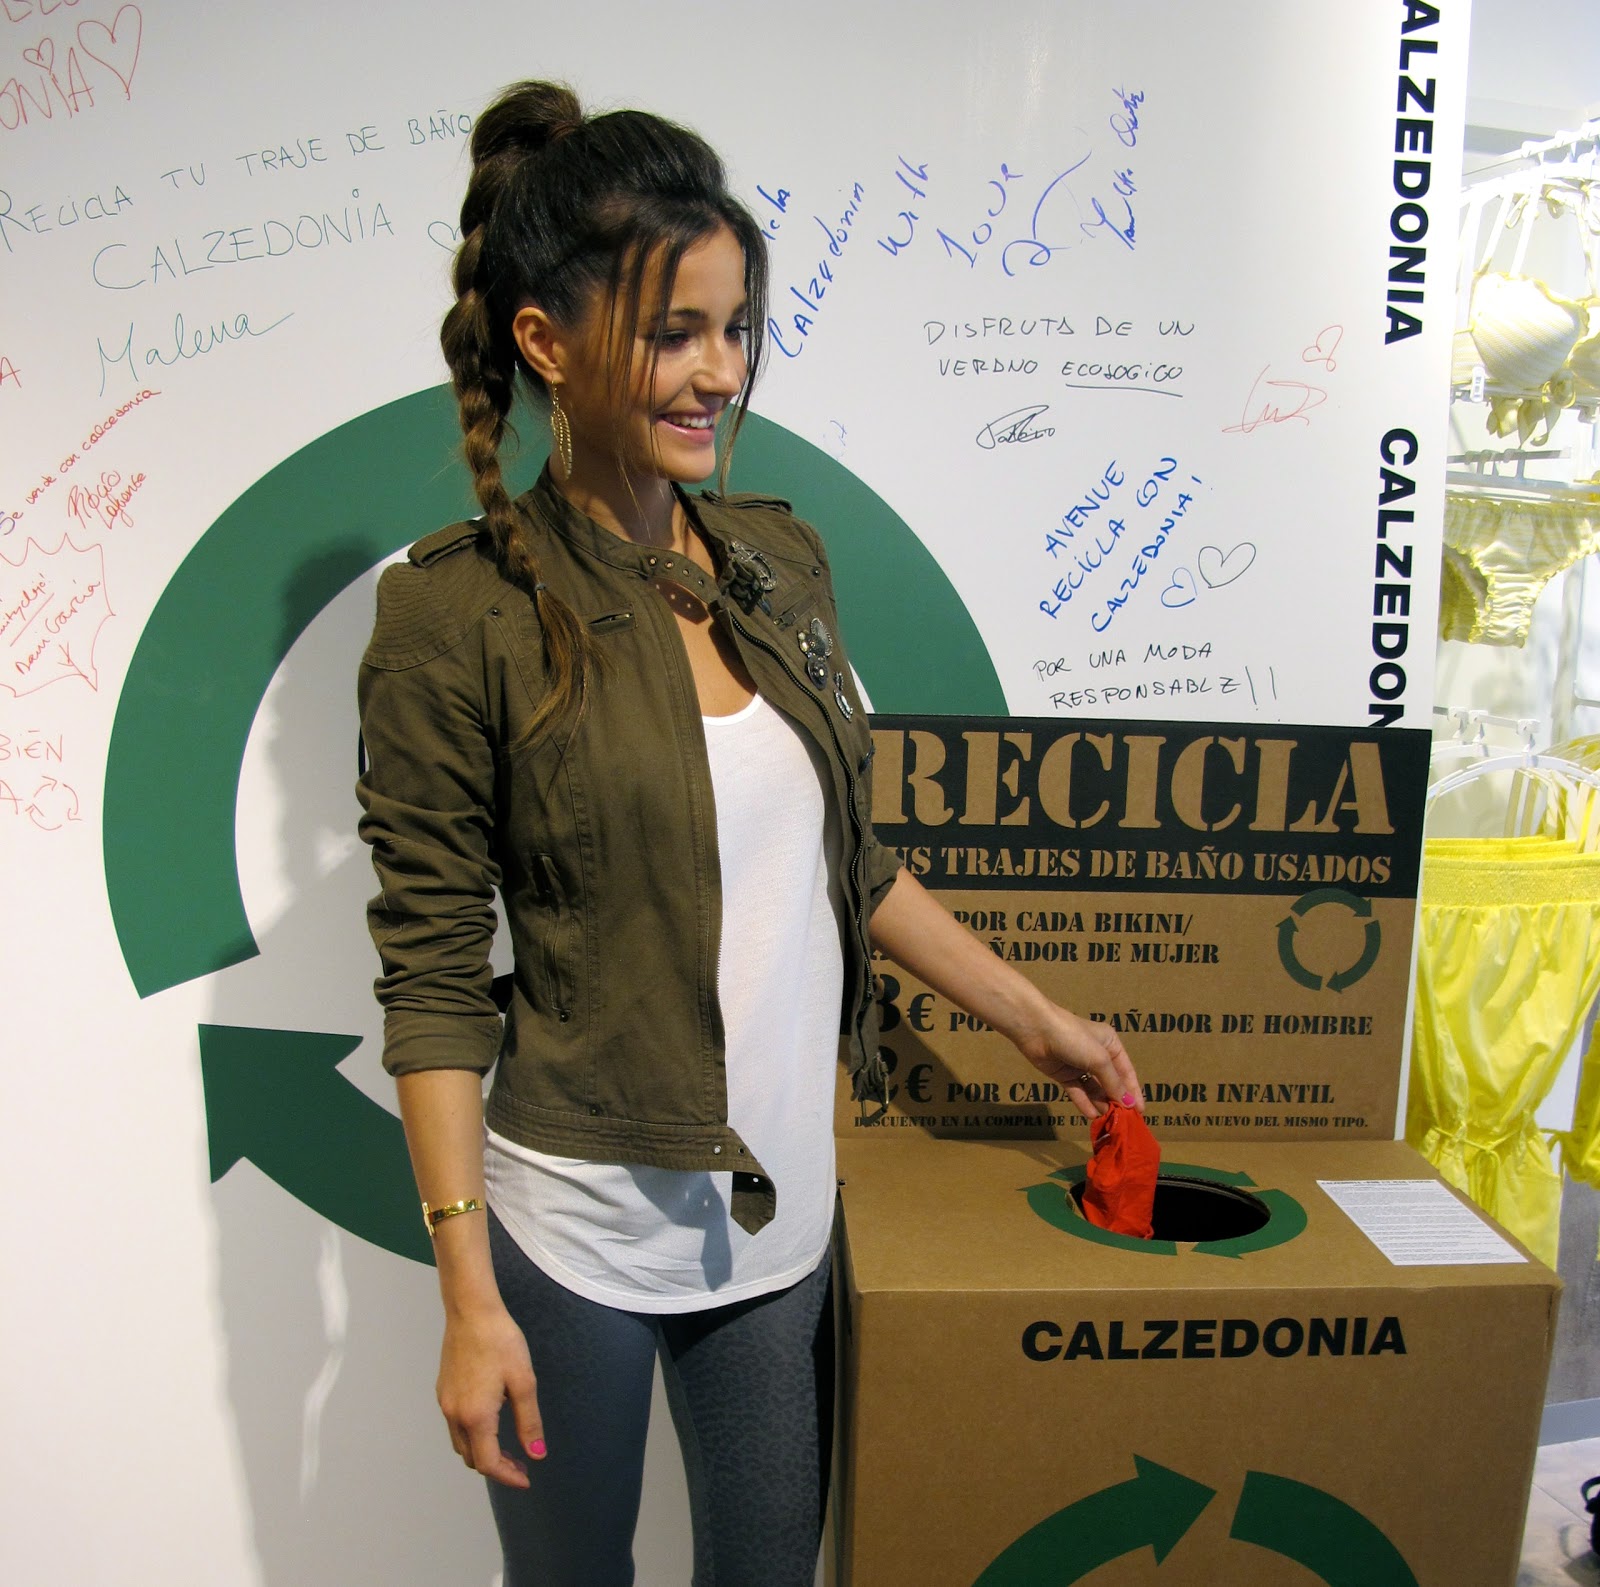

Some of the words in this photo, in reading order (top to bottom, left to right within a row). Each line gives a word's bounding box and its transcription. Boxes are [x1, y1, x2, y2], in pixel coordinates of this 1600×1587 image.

[161, 163, 205, 186] TU
[236, 138, 327, 176] TRAJE
[347, 126, 384, 156] DE
[408, 109, 472, 145] BAÑO
[924, 316, 1075, 345] DISFRUTA
[1096, 316, 1133, 337] DE
[1159, 320, 1195, 338] UN
[97, 312, 294, 397] Malena
[59, 453, 81, 474] con
[1045, 460, 1126, 559] AVENUE
[1032, 657, 1072, 682] POR
[1089, 649, 1126, 668] UNA
[1144, 642, 1213, 664] MODA
[870, 729, 1395, 835] RECICLA
[941, 847, 1081, 877] TRAJES
[1090, 849, 1136, 878] DE
[1145, 845, 1244, 881] BAÑO
[1254, 852, 1391, 884] USADOS
[953, 910, 1008, 931] POR
[1016, 911, 1085, 932] CADA
[1094, 912, 1194, 936] BIKINI/
[1087, 942, 1121, 963] DE
[1130, 943, 1220, 964] MUJER
[949, 1011, 994, 1032] PO
[1221, 1014, 1255, 1033] DE
[1263, 1014, 1374, 1035] HOMBRE
[947, 1082, 1001, 1103] POR
[1216, 1083, 1335, 1104] INFANTIL
[854, 1115, 937, 1128] DSCUENTO
[941, 1115, 959, 1127] EN
[963, 1115, 982, 1127] LA
[987, 1115, 1043, 1127] COMPRA
[1048, 1115, 1066, 1127] DE
[1070, 1115, 1089, 1127] UN
[1163, 1113, 1201, 1127] BAÑO
[1205, 1115, 1251, 1127] NUEVO
[1254, 1115, 1280, 1128] DEL
[1283, 1116, 1329, 1128] MISMO
[1333, 1116, 1369, 1128] TIPO.
[1020, 1316, 1408, 1362] CALZEDONIA
